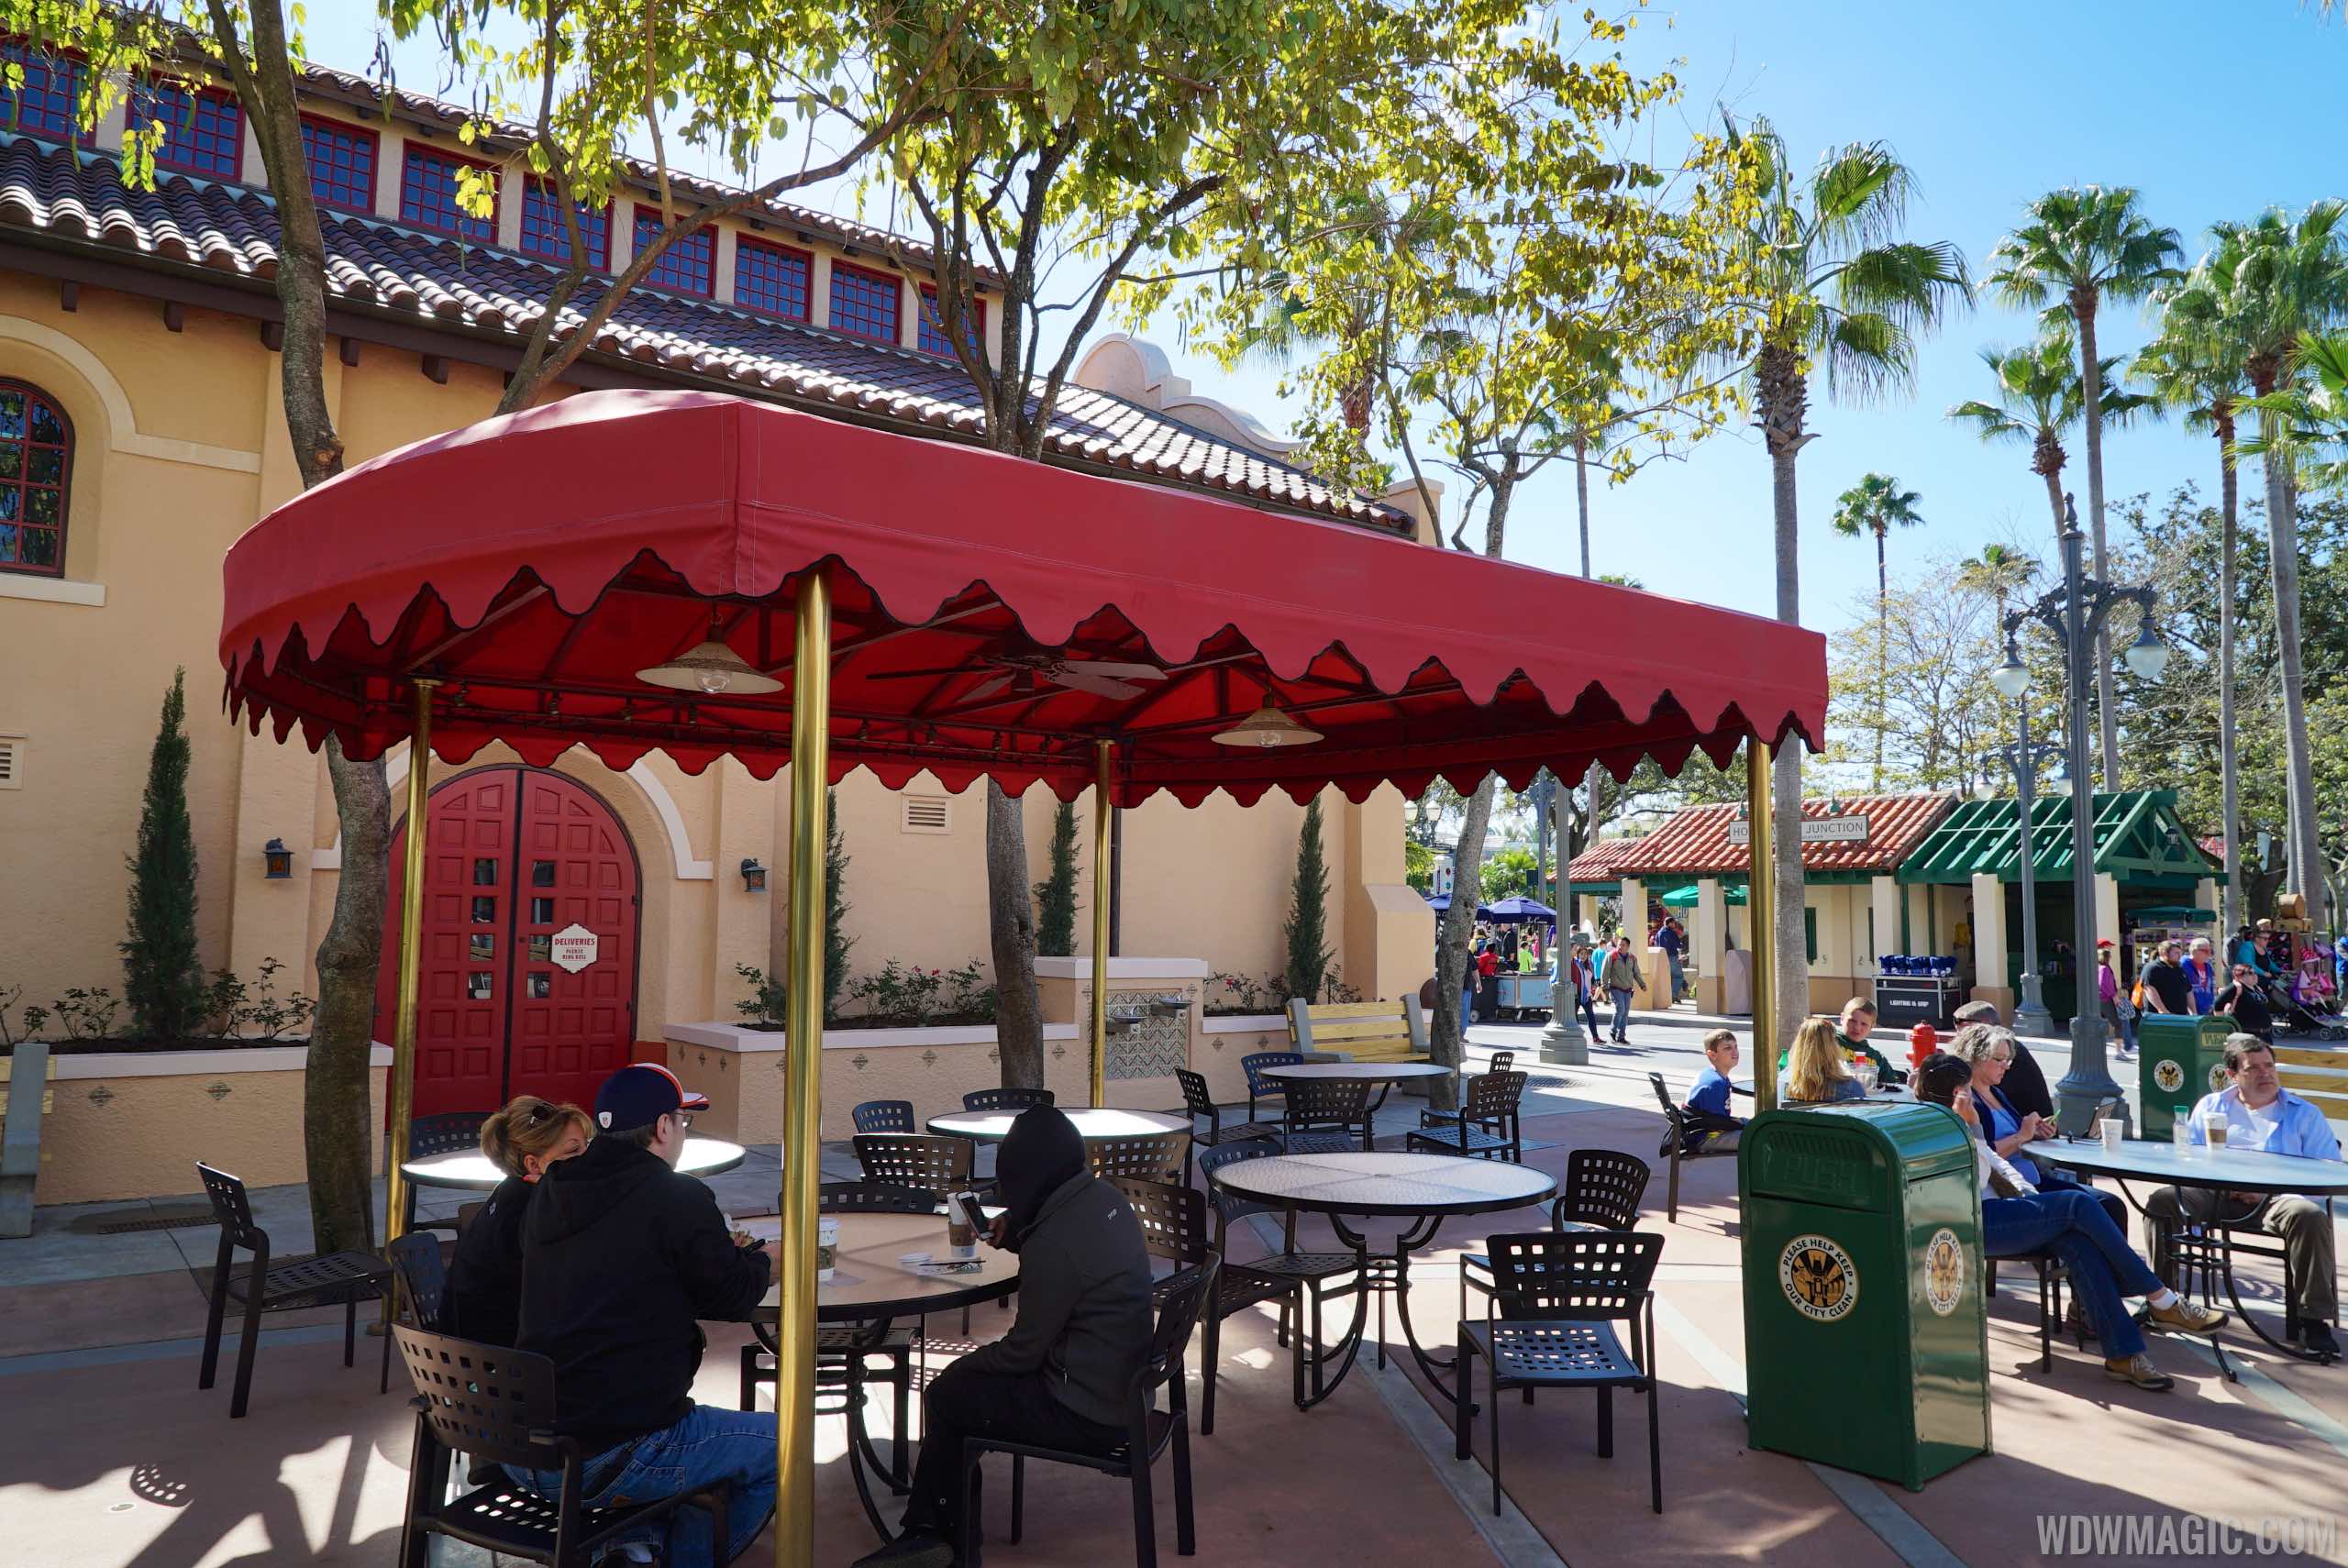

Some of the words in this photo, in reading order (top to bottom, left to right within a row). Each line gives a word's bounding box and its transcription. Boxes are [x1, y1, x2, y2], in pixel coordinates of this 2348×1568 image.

[1806, 822, 1863, 834] JUNCTION
[1783, 1239, 1808, 1267] PLEASE
[1810, 1239, 1834, 1252] HELP
[1835, 1252, 1854, 1277] KEEP
[1785, 1283, 1802, 1306] OUR
[1804, 1305, 1826, 1318] CITY
[1829, 1293, 1854, 1317] CLEAN
